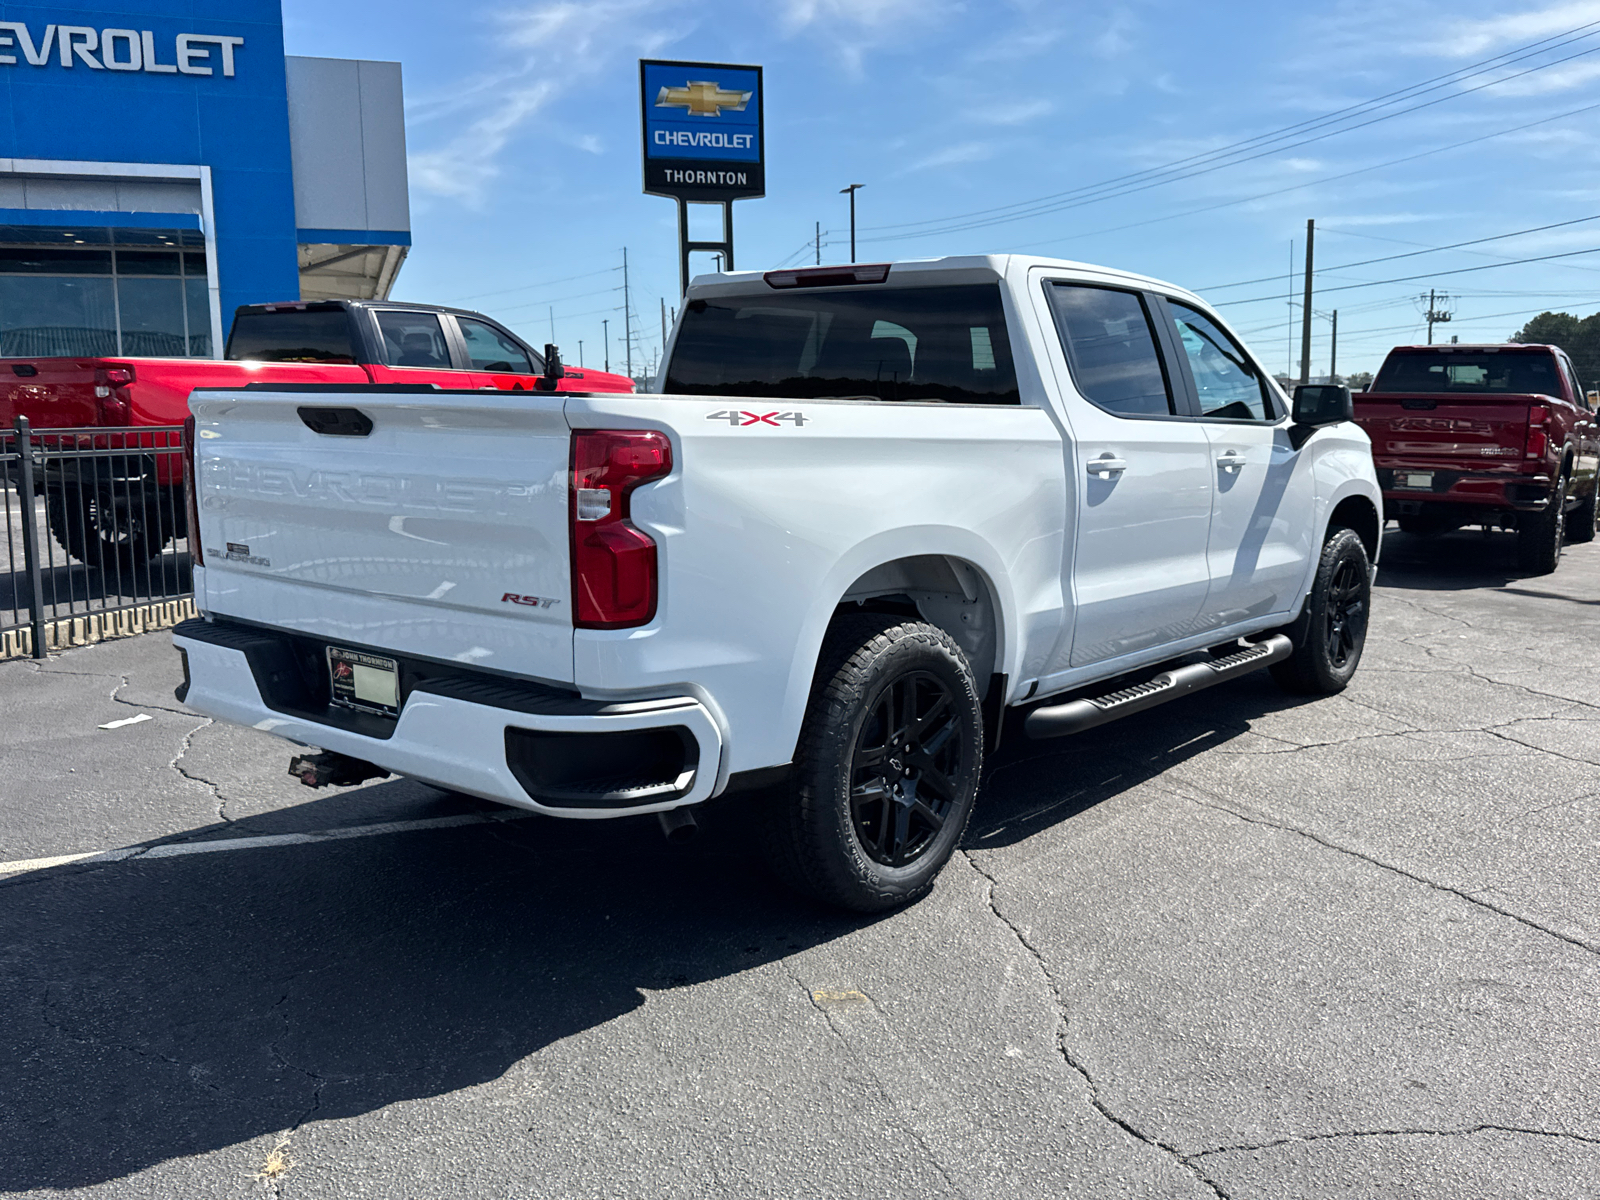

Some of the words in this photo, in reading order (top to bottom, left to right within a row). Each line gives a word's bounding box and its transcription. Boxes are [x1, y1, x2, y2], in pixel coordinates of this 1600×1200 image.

[654, 130, 753, 149] CHEVROLET
[664, 169, 747, 185] THORNTON
[501, 592, 561, 609] RST
[342, 651, 359, 661] JOHN
[359, 655, 393, 669] THORNTON
